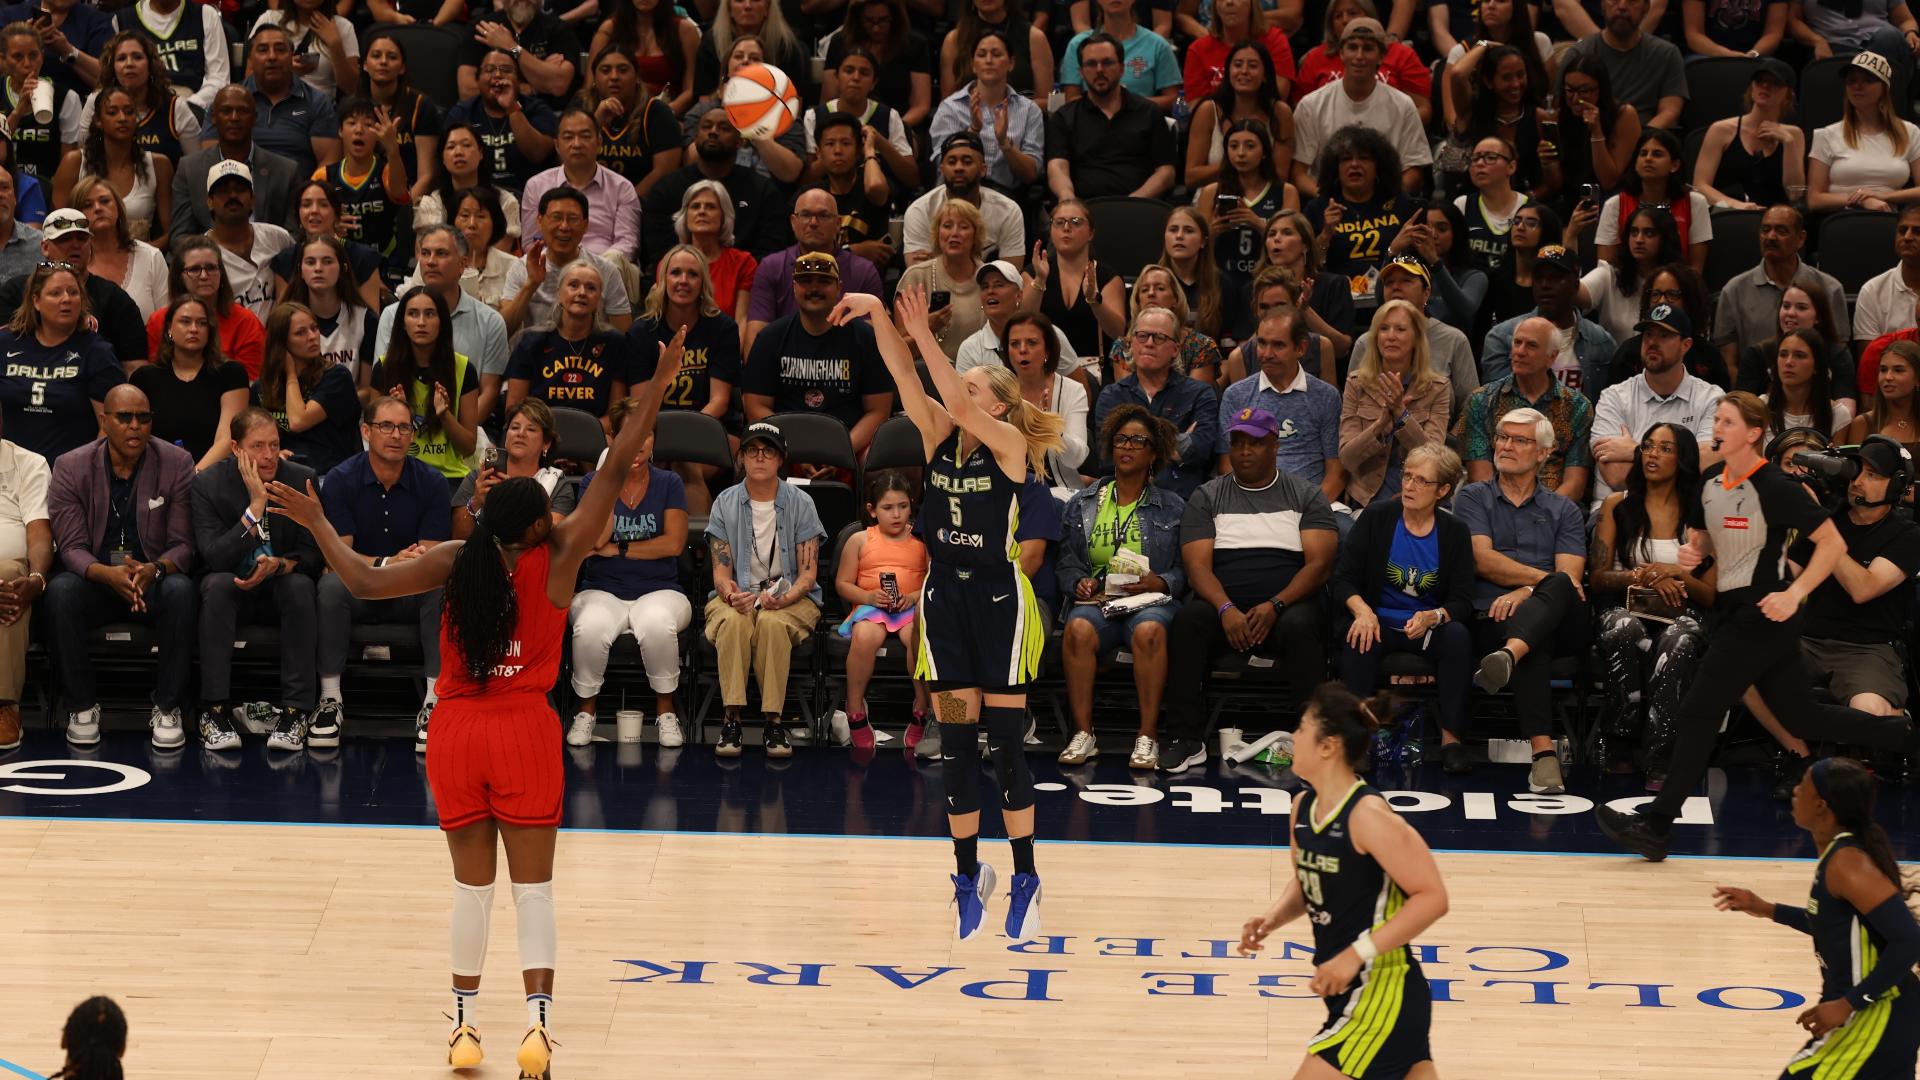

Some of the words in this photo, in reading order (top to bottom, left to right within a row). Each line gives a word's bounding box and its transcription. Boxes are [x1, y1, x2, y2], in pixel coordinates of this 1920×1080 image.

[156, 39, 198, 54] LLAS
[1334, 213, 1400, 234] NDIANA
[1239, 229, 1252, 255] 5
[1348, 230, 1381, 260] 22
[6, 362, 80, 379] DALLAS
[542, 354, 604, 379] CAITLIN
[567, 372, 578, 384] 22
[30, 381, 47, 406] 5
[548, 385, 596, 400] FEVER
[1240, 407, 1252, 421] 3
[931, 470, 993, 494] DALLAS
[948, 495, 963, 528] 5
[1297, 848, 1340, 874] LLAS
[610, 958, 1068, 1002] PARK
